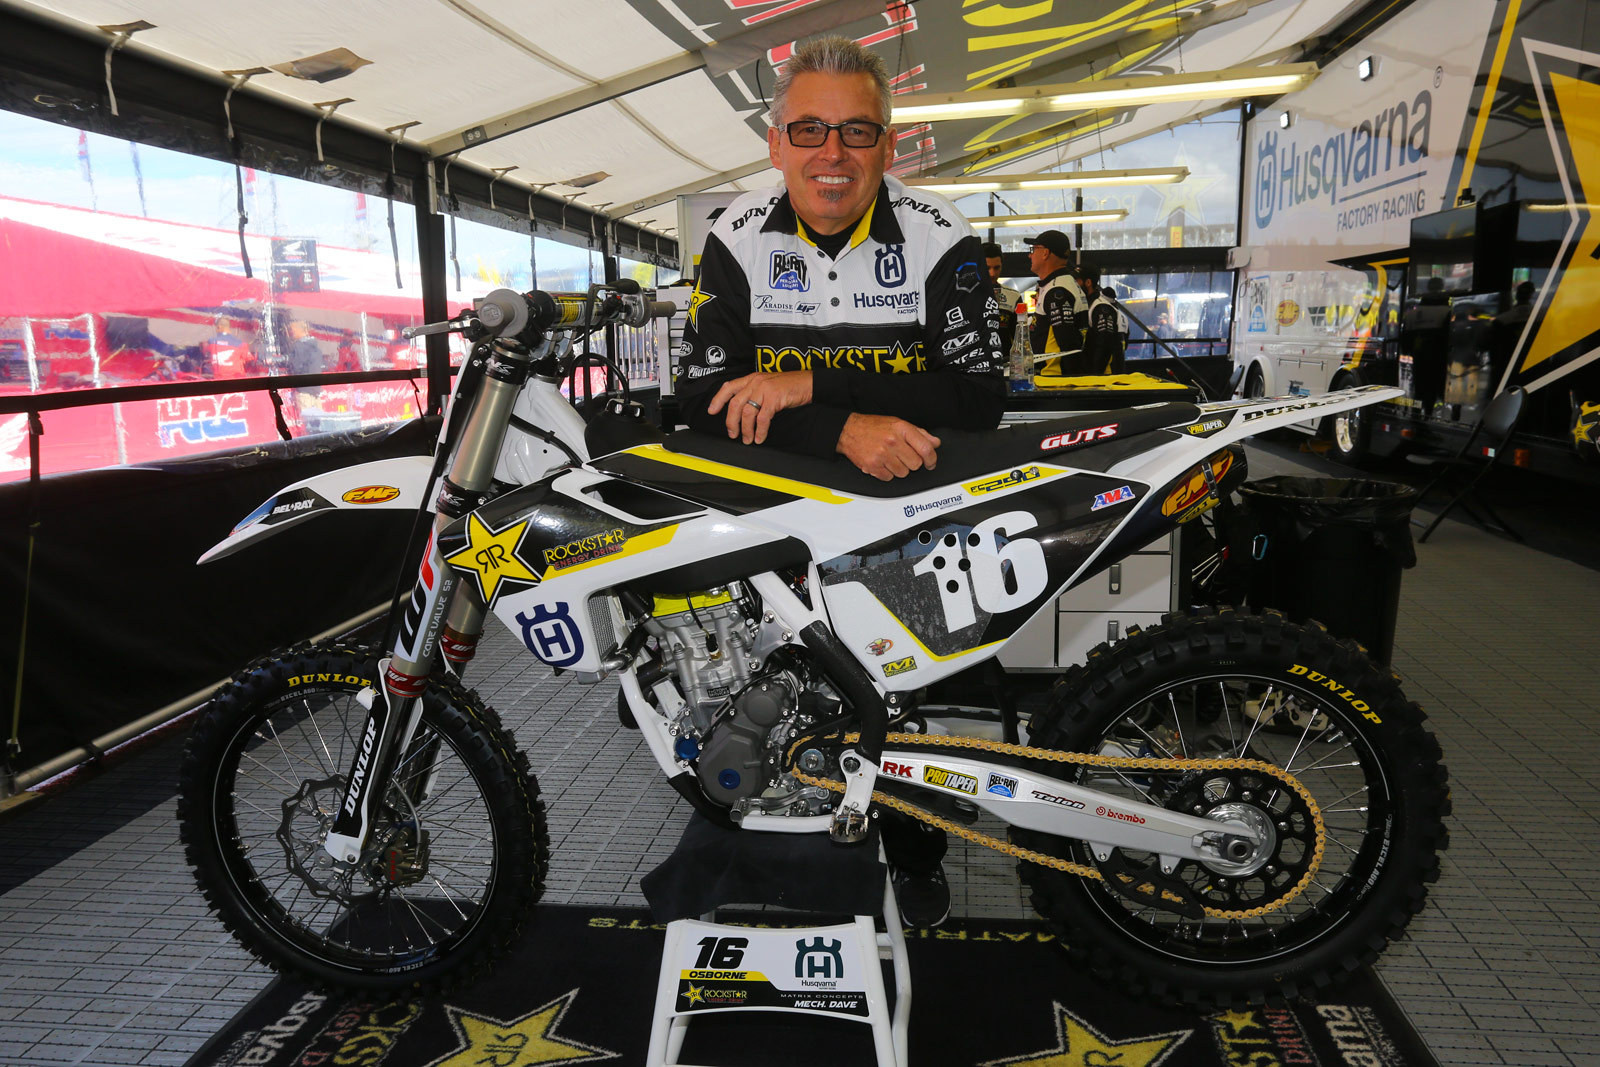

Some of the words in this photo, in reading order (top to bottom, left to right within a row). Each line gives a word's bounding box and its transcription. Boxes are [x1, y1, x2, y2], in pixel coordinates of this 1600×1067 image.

[1278, 89, 1433, 206] Husqvarna
[1337, 204, 1381, 232] FACTORY
[1382, 189, 1426, 226] RACING
[1041, 423, 1118, 450] GUTS
[347, 487, 400, 502] FMF
[915, 494, 962, 513] Husqvarna
[1092, 486, 1135, 508] AMA
[554, 552, 589, 569] ENERGY
[593, 545, 621, 557] DRINK
[912, 510, 1049, 634] 16
[287, 673, 372, 688] DUNLOP
[1287, 664, 1382, 724] DUNLOP
[344, 717, 377, 817] DUNLOP
[882, 761, 914, 778] RK
[925, 769, 977, 793] PROTAPER
[1107, 809, 1146, 824] brembo
[1375, 838, 1390, 868] EXCEL
[694, 937, 749, 969] 16
[689, 971, 748, 980] OSBORNE
[801, 980, 837, 988] Husqvarna
[829, 1001, 858, 1009] DAVE
